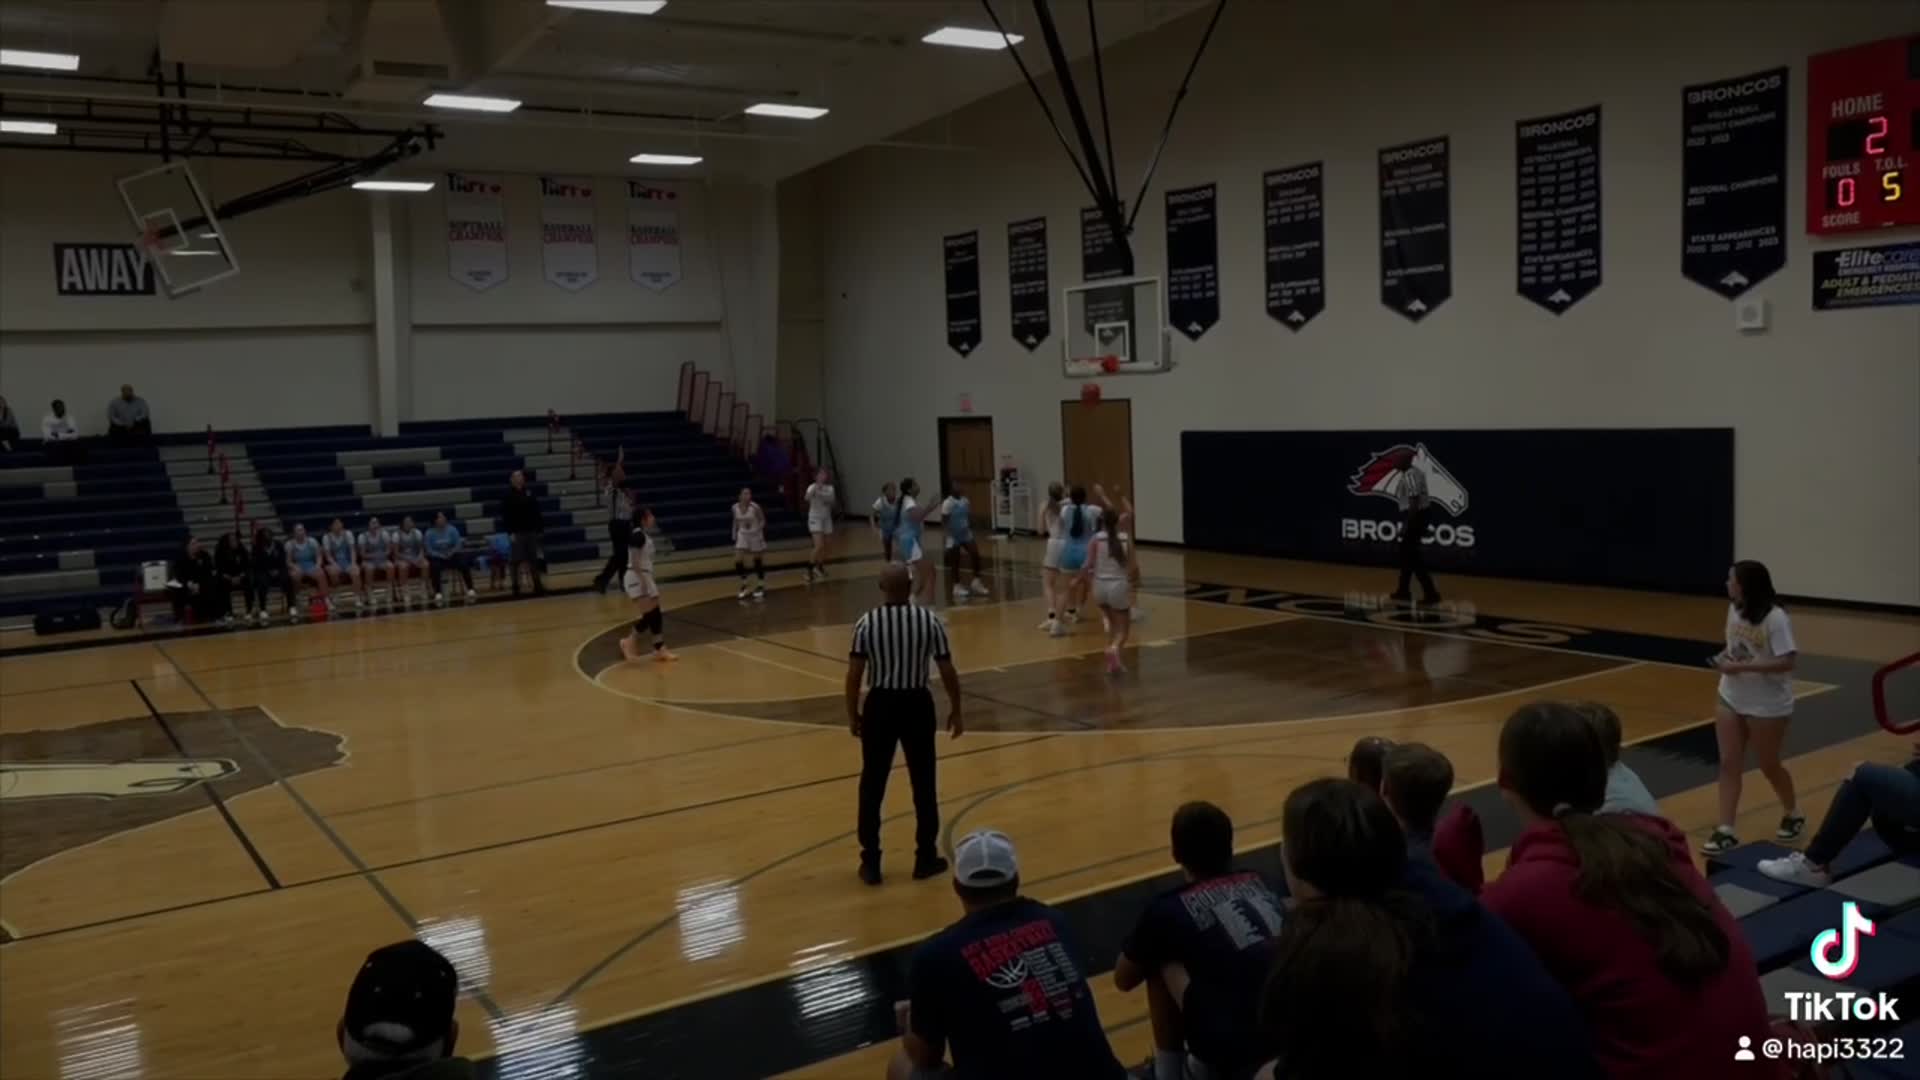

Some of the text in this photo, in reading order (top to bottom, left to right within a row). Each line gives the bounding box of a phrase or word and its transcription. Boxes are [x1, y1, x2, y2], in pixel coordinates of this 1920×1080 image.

[1687, 75, 1782, 104] BRONCOS
[1831, 93, 1885, 118] HOME
[1520, 112, 1597, 138] BRONCOS
[1865, 116, 1888, 155] 2
[1822, 155, 1909, 179] FOULS T.O.L.
[1836, 170, 1902, 207] 0 5
[1821, 211, 1862, 229] SCORE
[61, 248, 148, 291] AWAY
[1821, 277, 1860, 289] ADULT
